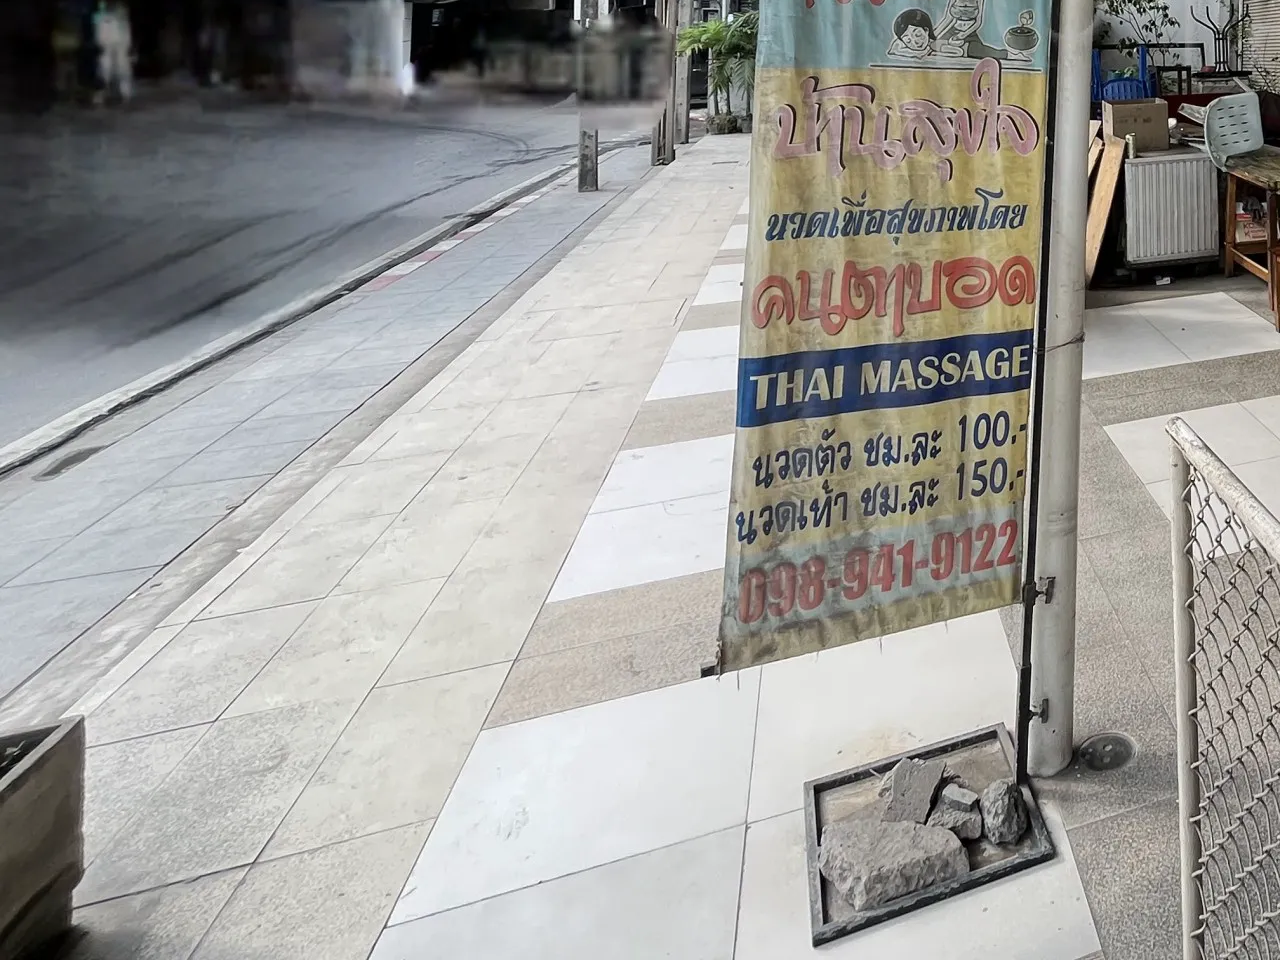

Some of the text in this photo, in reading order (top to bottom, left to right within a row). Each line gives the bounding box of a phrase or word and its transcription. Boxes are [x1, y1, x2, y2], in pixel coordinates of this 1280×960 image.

[772, 57, 1040, 183] บ้านสุขใจ
[765, 187, 1029, 246] นวดเพื่อสุขภาพโดย
[751, 255, 1036, 336] คนตาบอด
[749, 343, 1031, 411] THAI MASSAGE
[752, 427, 853, 490] นวดตัว
[863, 427, 943, 468] ชม.ละ
[736, 479, 849, 545] นวดเท้า
[860, 476, 940, 520] ชม.ละ
[737, 518, 1020, 625] 098-941-9122
